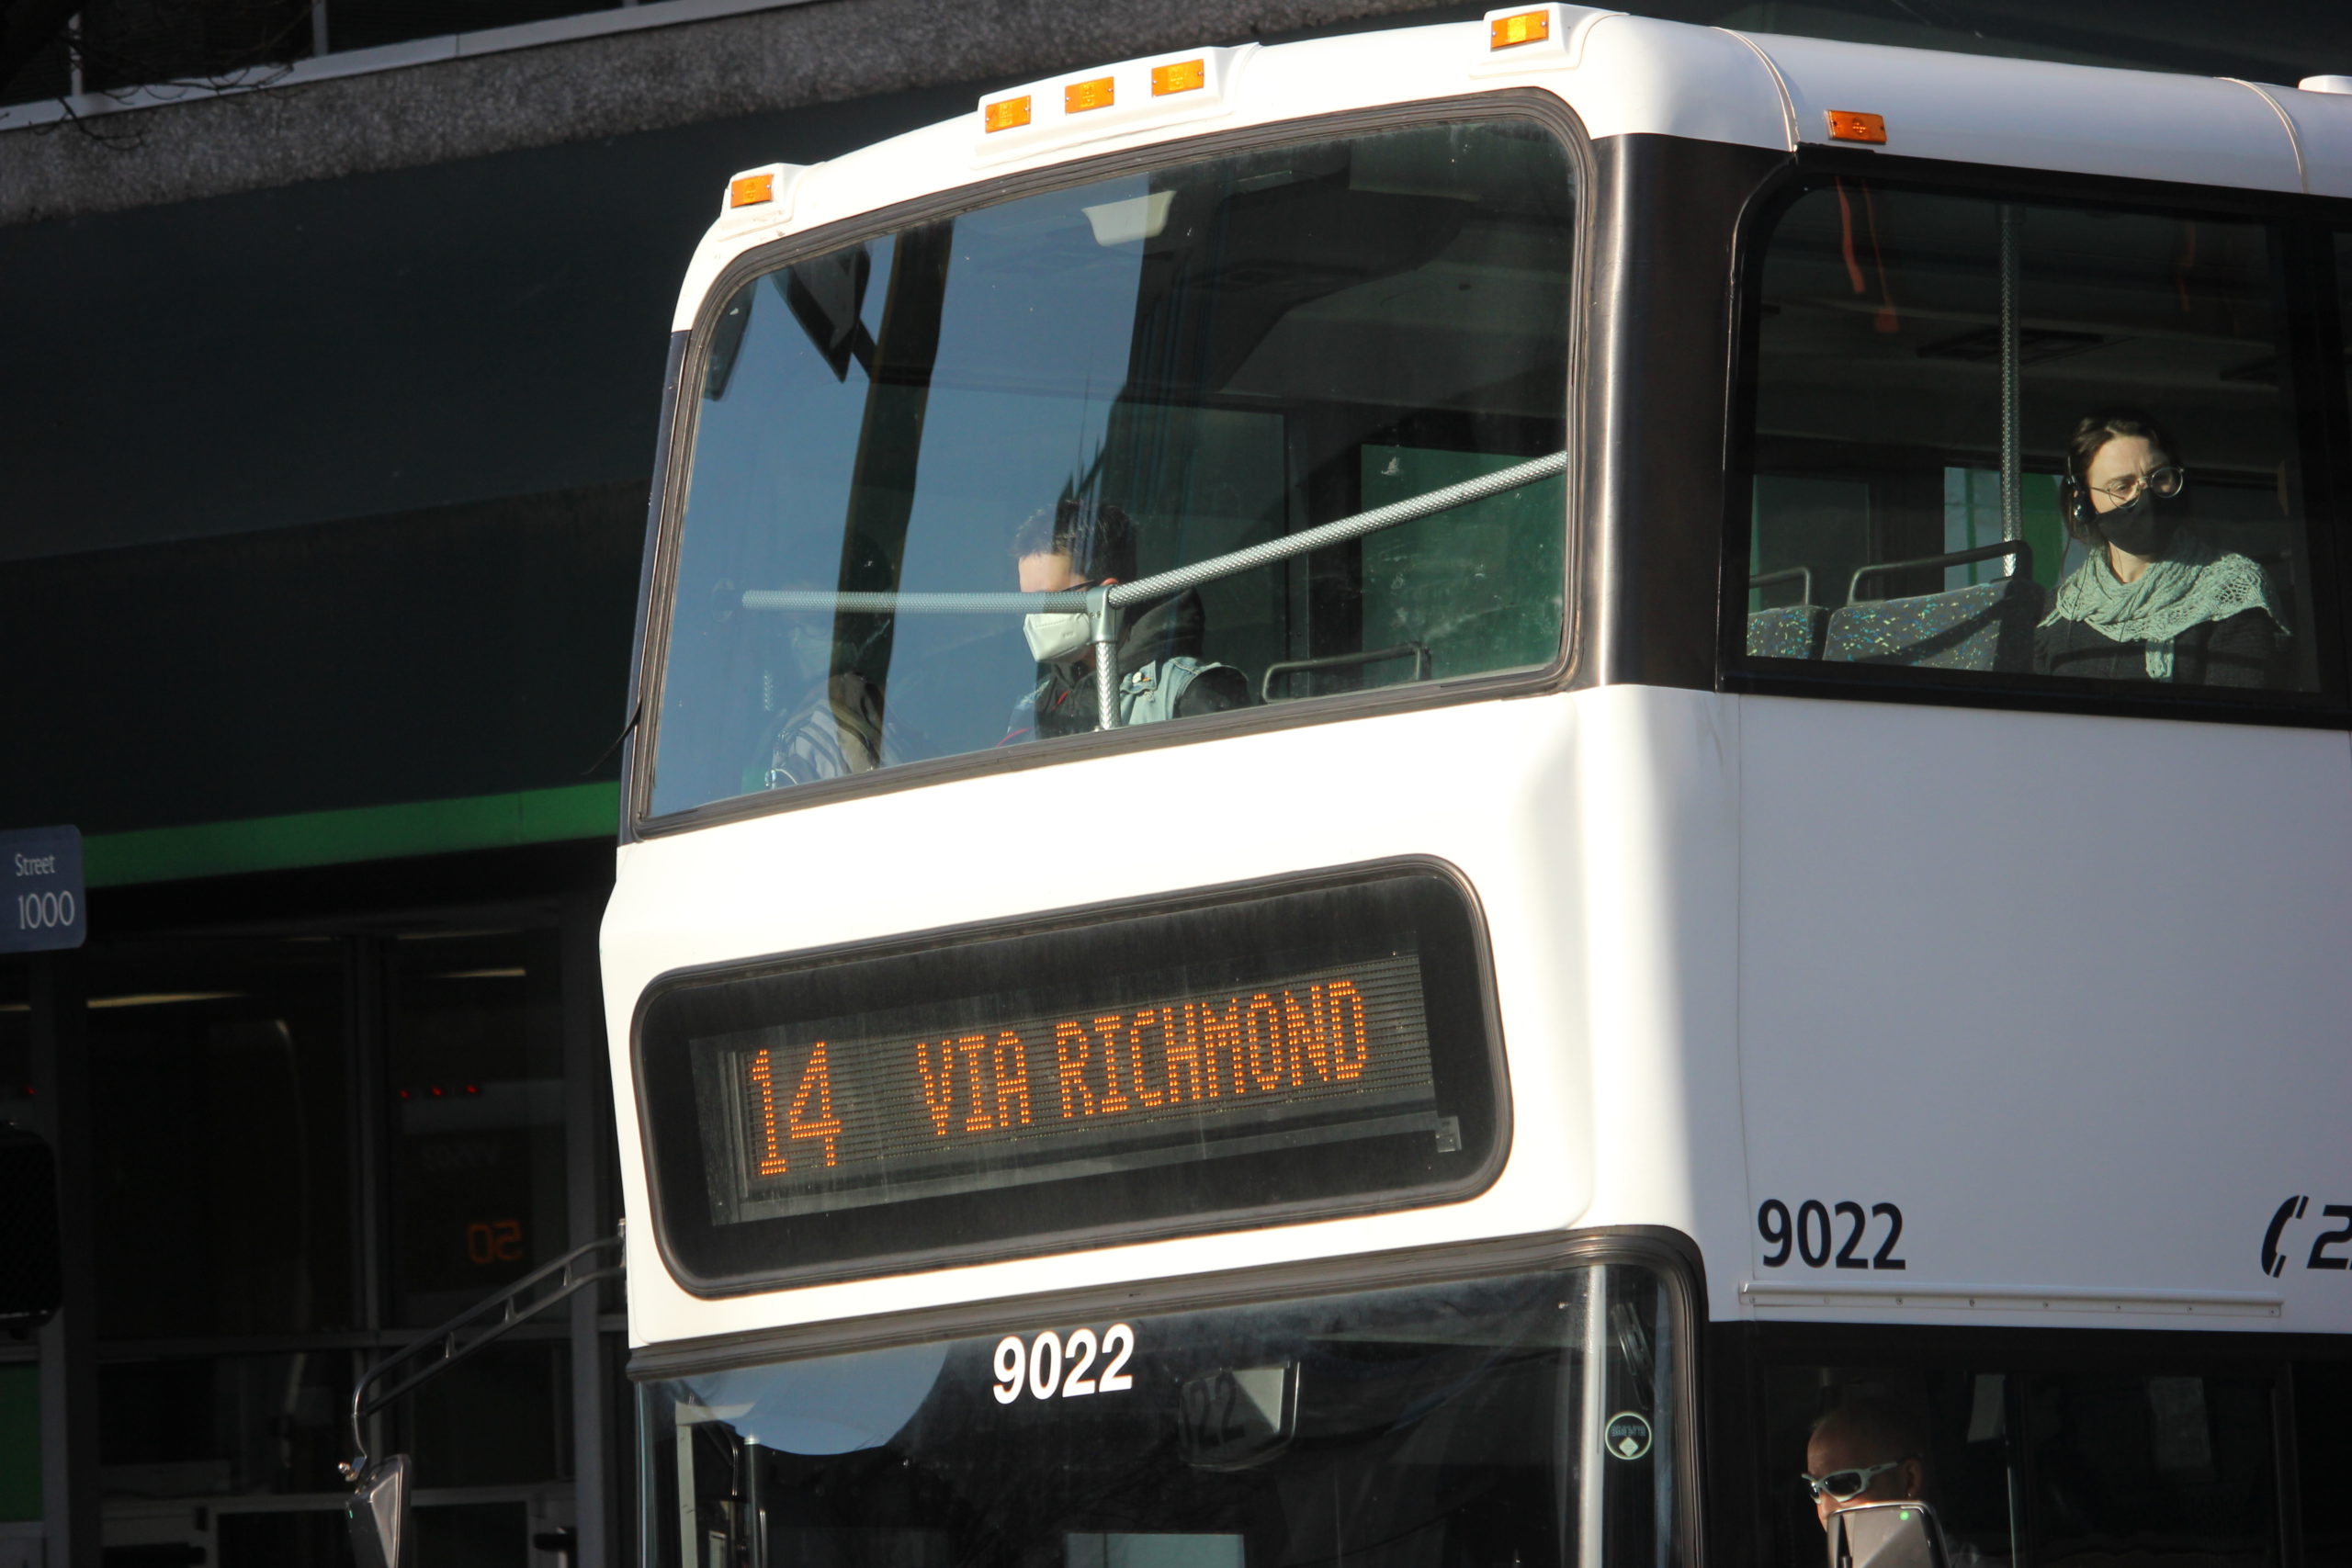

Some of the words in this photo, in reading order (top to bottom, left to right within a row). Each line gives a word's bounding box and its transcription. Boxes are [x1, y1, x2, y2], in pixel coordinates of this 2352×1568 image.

[15, 853, 55, 876] Street
[18, 890, 74, 930] 1000
[752, 1041, 842, 1177] 14
[916, 1030, 1031, 1135] VIA
[1056, 980, 1368, 1119] RICHMOND
[1758, 1199, 1906, 1269] 9022
[2306, 1204, 2352, 1270] 2
[993, 1323, 1135, 1404] 9022
